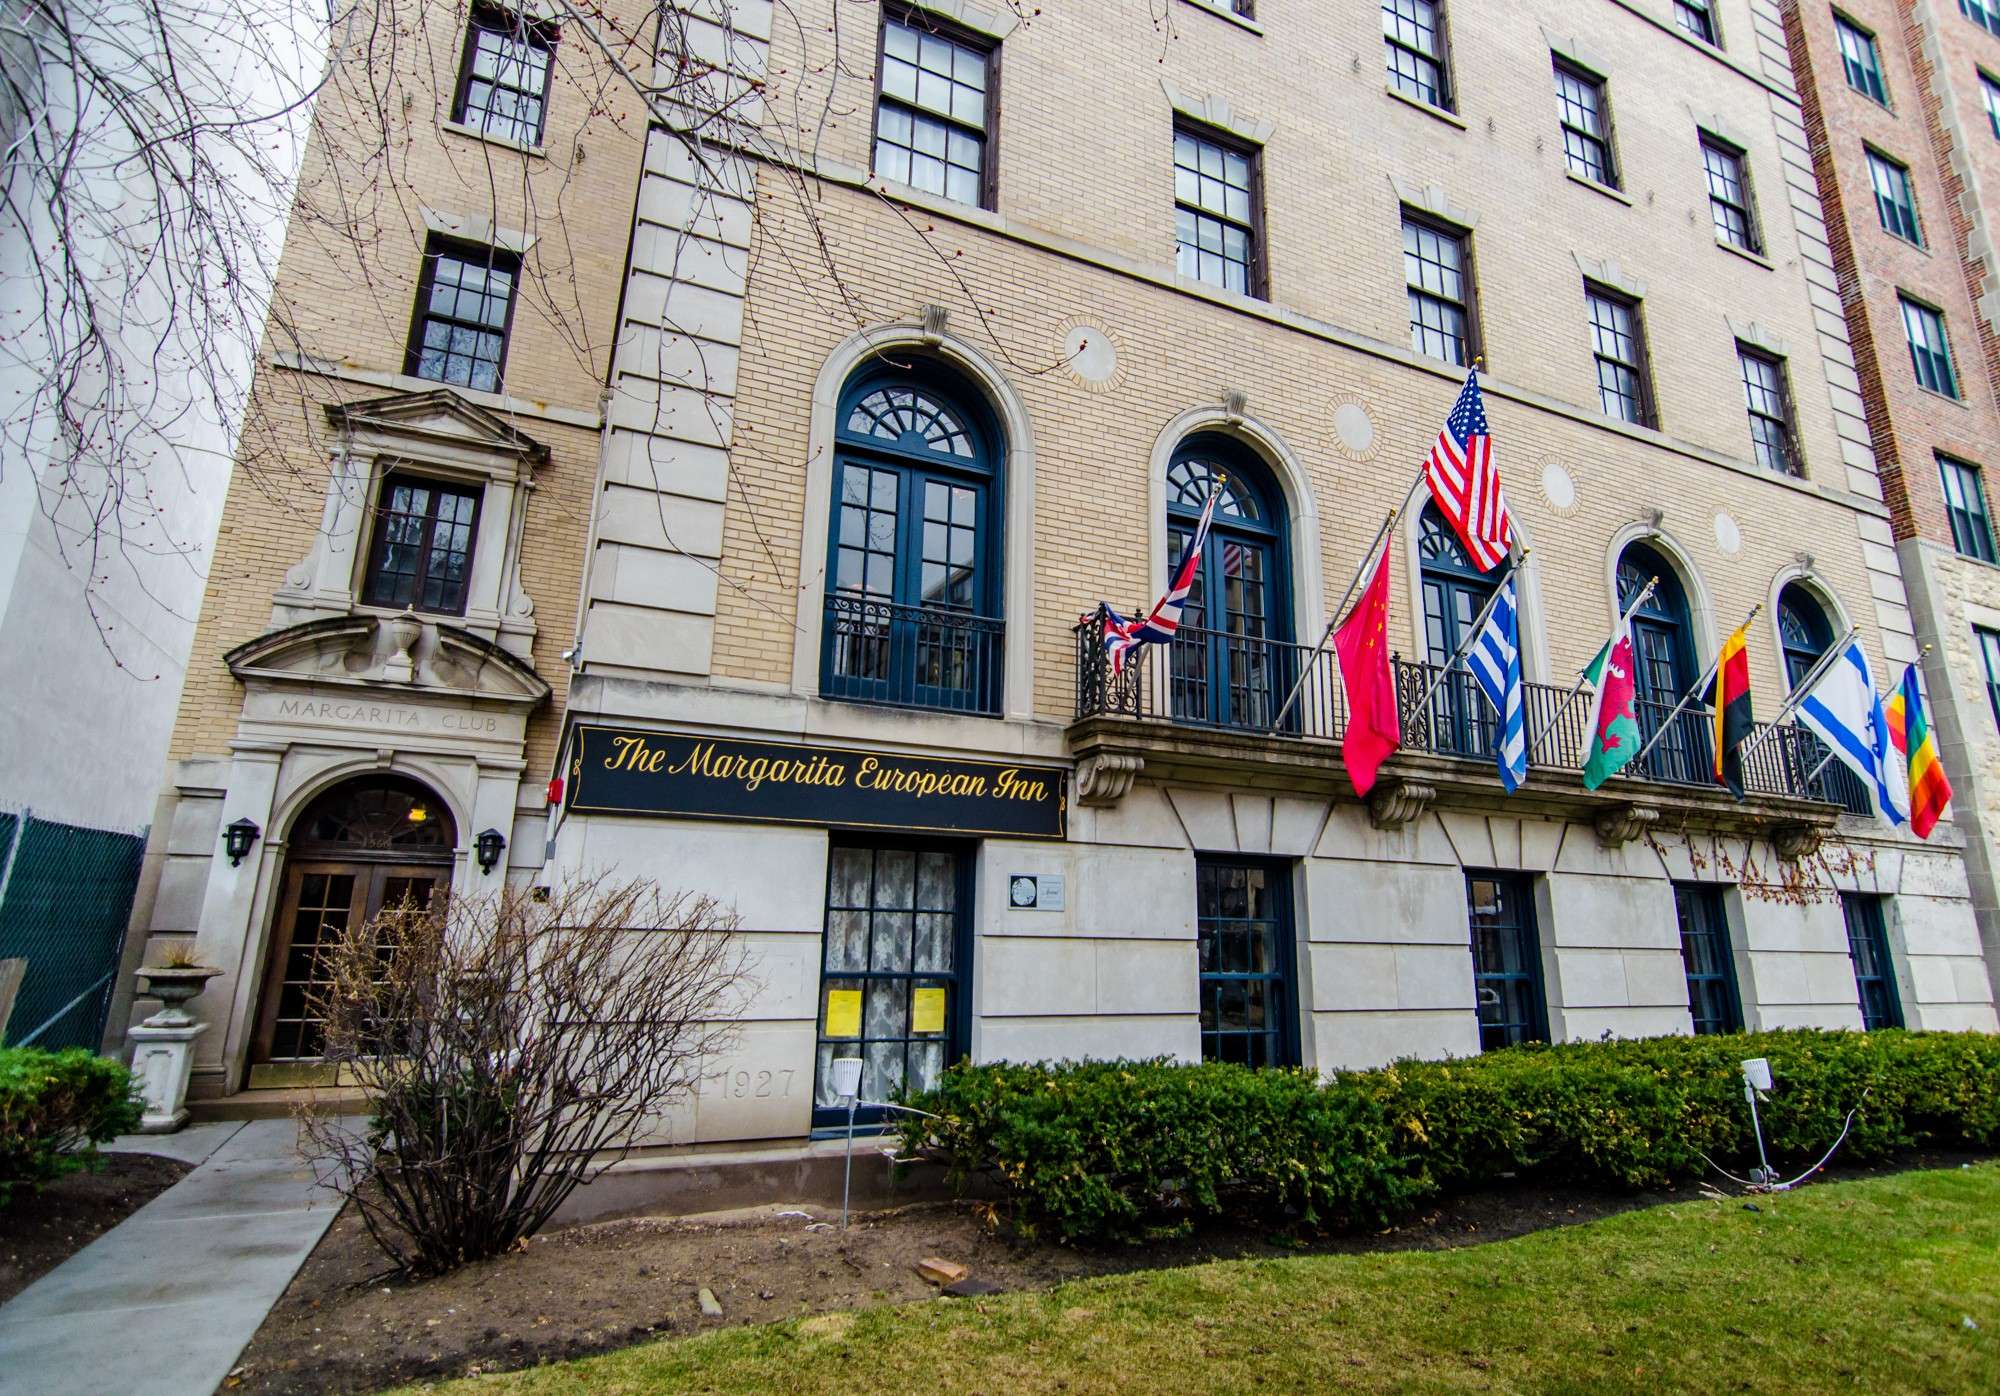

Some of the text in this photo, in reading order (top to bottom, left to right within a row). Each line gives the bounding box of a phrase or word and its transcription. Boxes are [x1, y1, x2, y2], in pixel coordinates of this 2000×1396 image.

[279, 699, 497, 732] MARGARITA CLUB
[605, 737, 1049, 802] The Margarita European Inn
[722, 1067, 795, 1099] 1927
